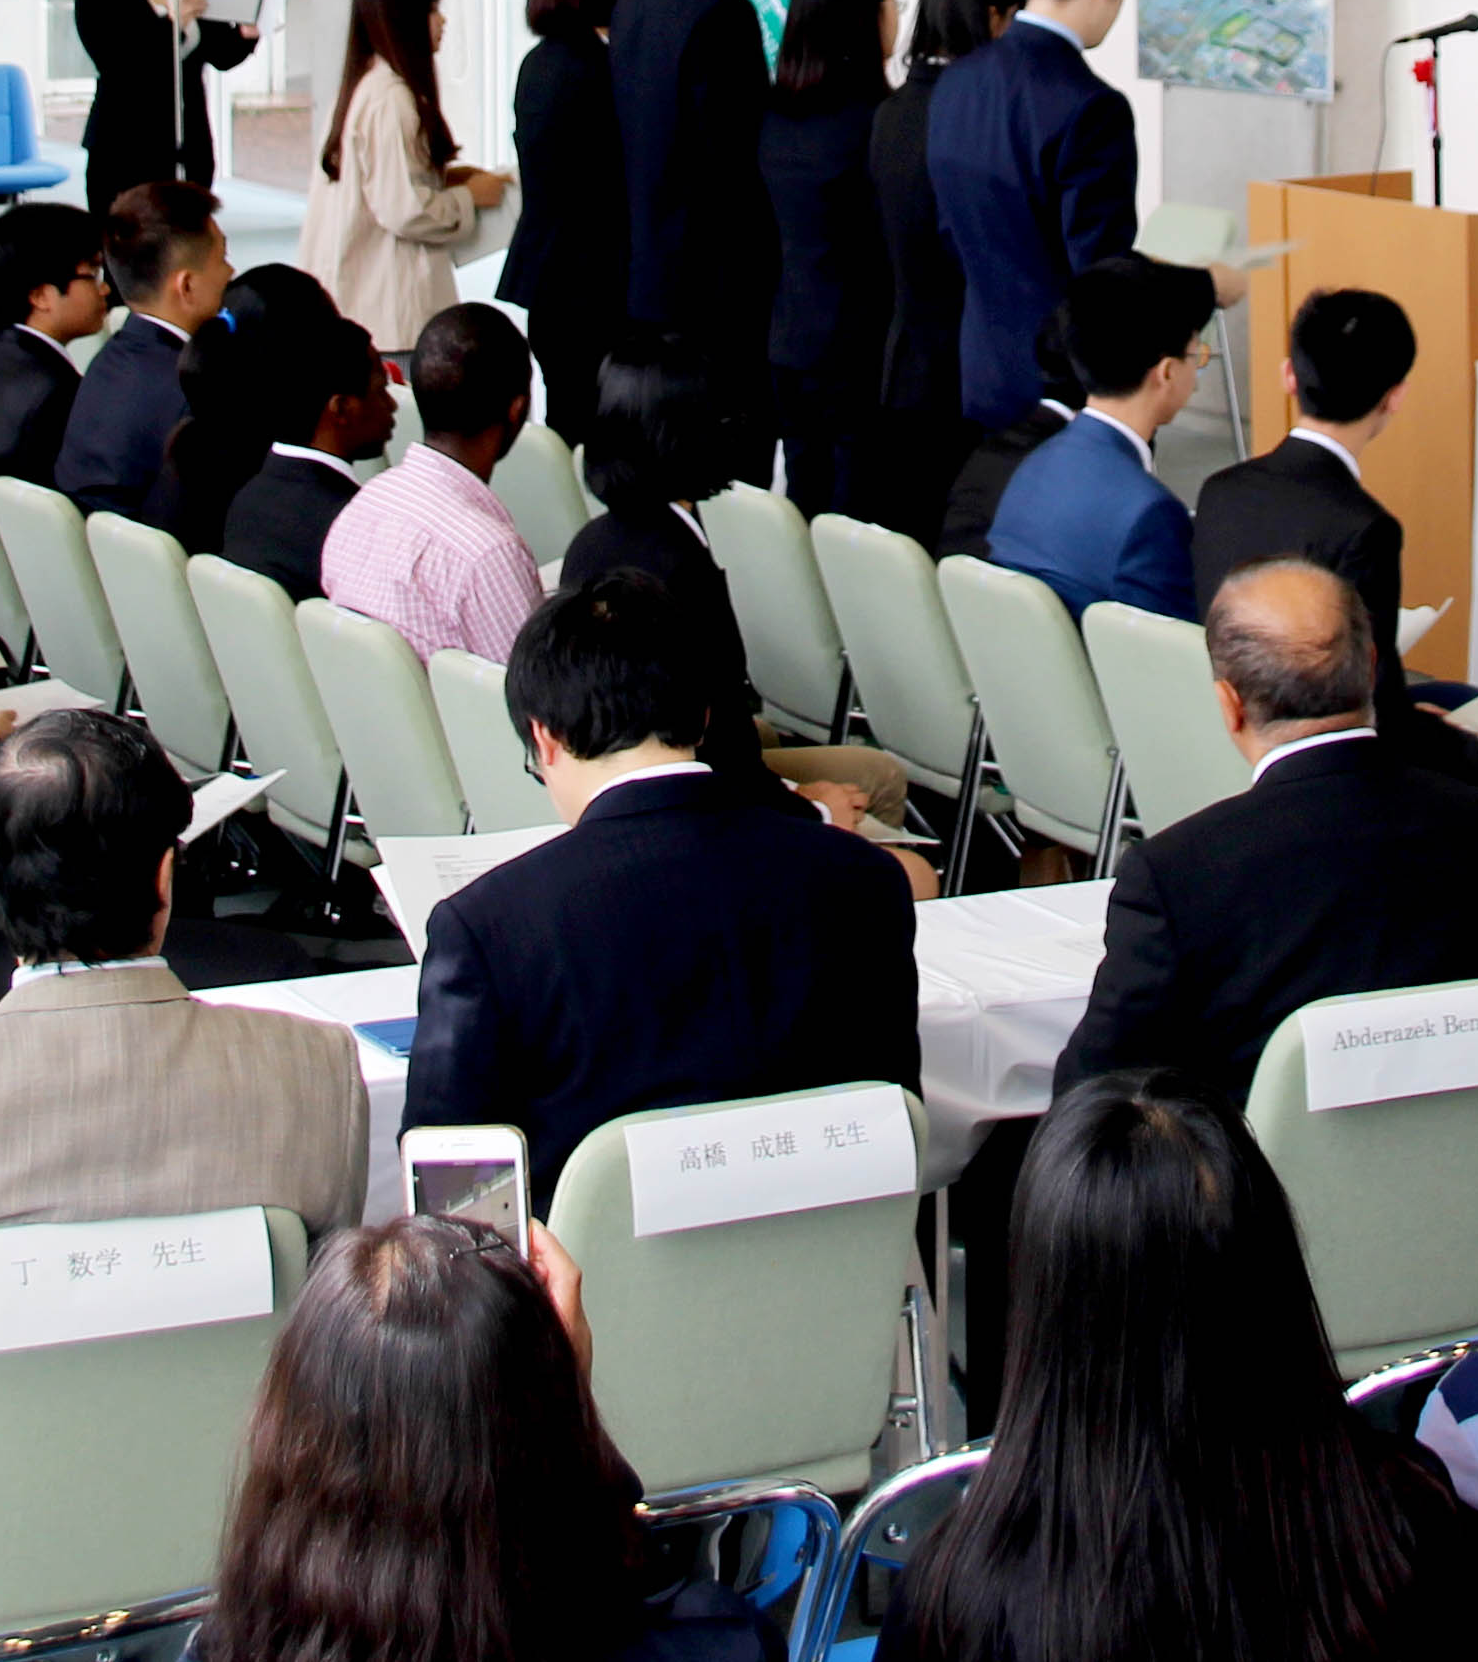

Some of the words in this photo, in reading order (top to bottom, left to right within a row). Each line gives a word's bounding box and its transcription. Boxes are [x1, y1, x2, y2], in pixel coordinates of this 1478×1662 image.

[1332, 1020, 1437, 1052] Abderazek
[679, 1141, 728, 1173] 高橋
[751, 1130, 800, 1161] 成雄
[823, 1121, 870, 1149] 先生
[11, 1257, 37, 1287] 丁
[67, 1248, 123, 1280] 数学
[153, 1237, 207, 1270] 先生
